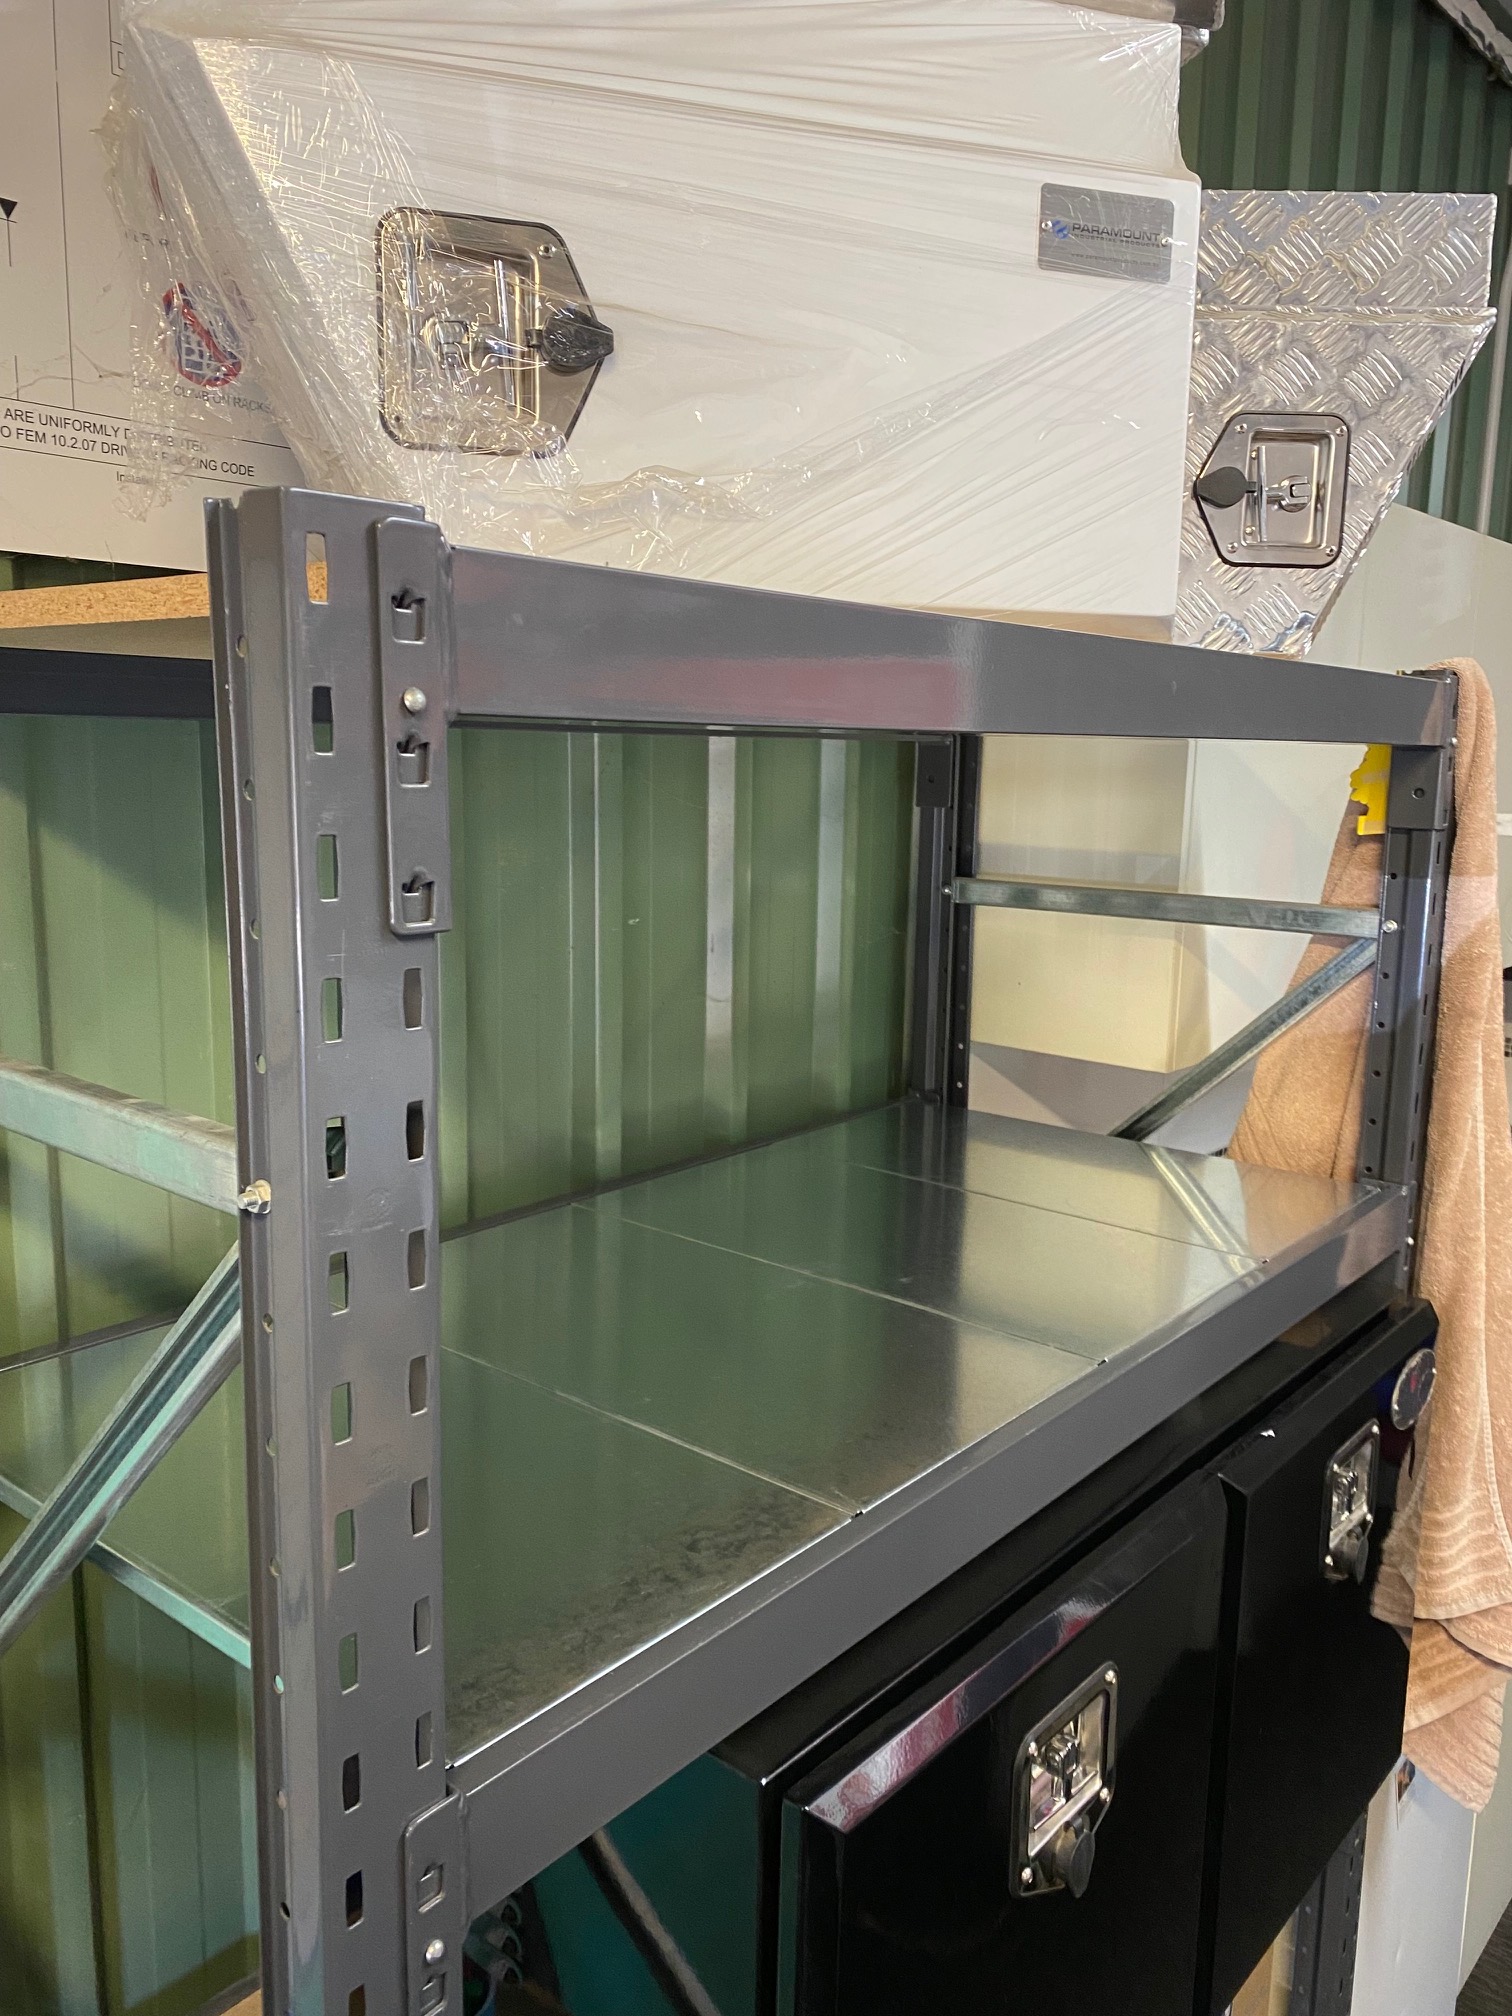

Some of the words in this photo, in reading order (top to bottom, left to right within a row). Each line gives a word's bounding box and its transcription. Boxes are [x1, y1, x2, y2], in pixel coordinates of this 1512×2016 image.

[1072, 223, 1160, 241] PARAMOUNT
[1072, 233, 1117, 243] INDUSTRIAL
[1120, 239, 1160, 248] PRODUCTS
[173, 385, 209, 402] CLB
[3, 408, 34, 424] ARE
[38, 413, 121, 438] UNIFORMLY
[16, 428, 46, 444] FEM
[51, 434, 97, 452] 10.2.07
[220, 461, 255, 477] CODE
